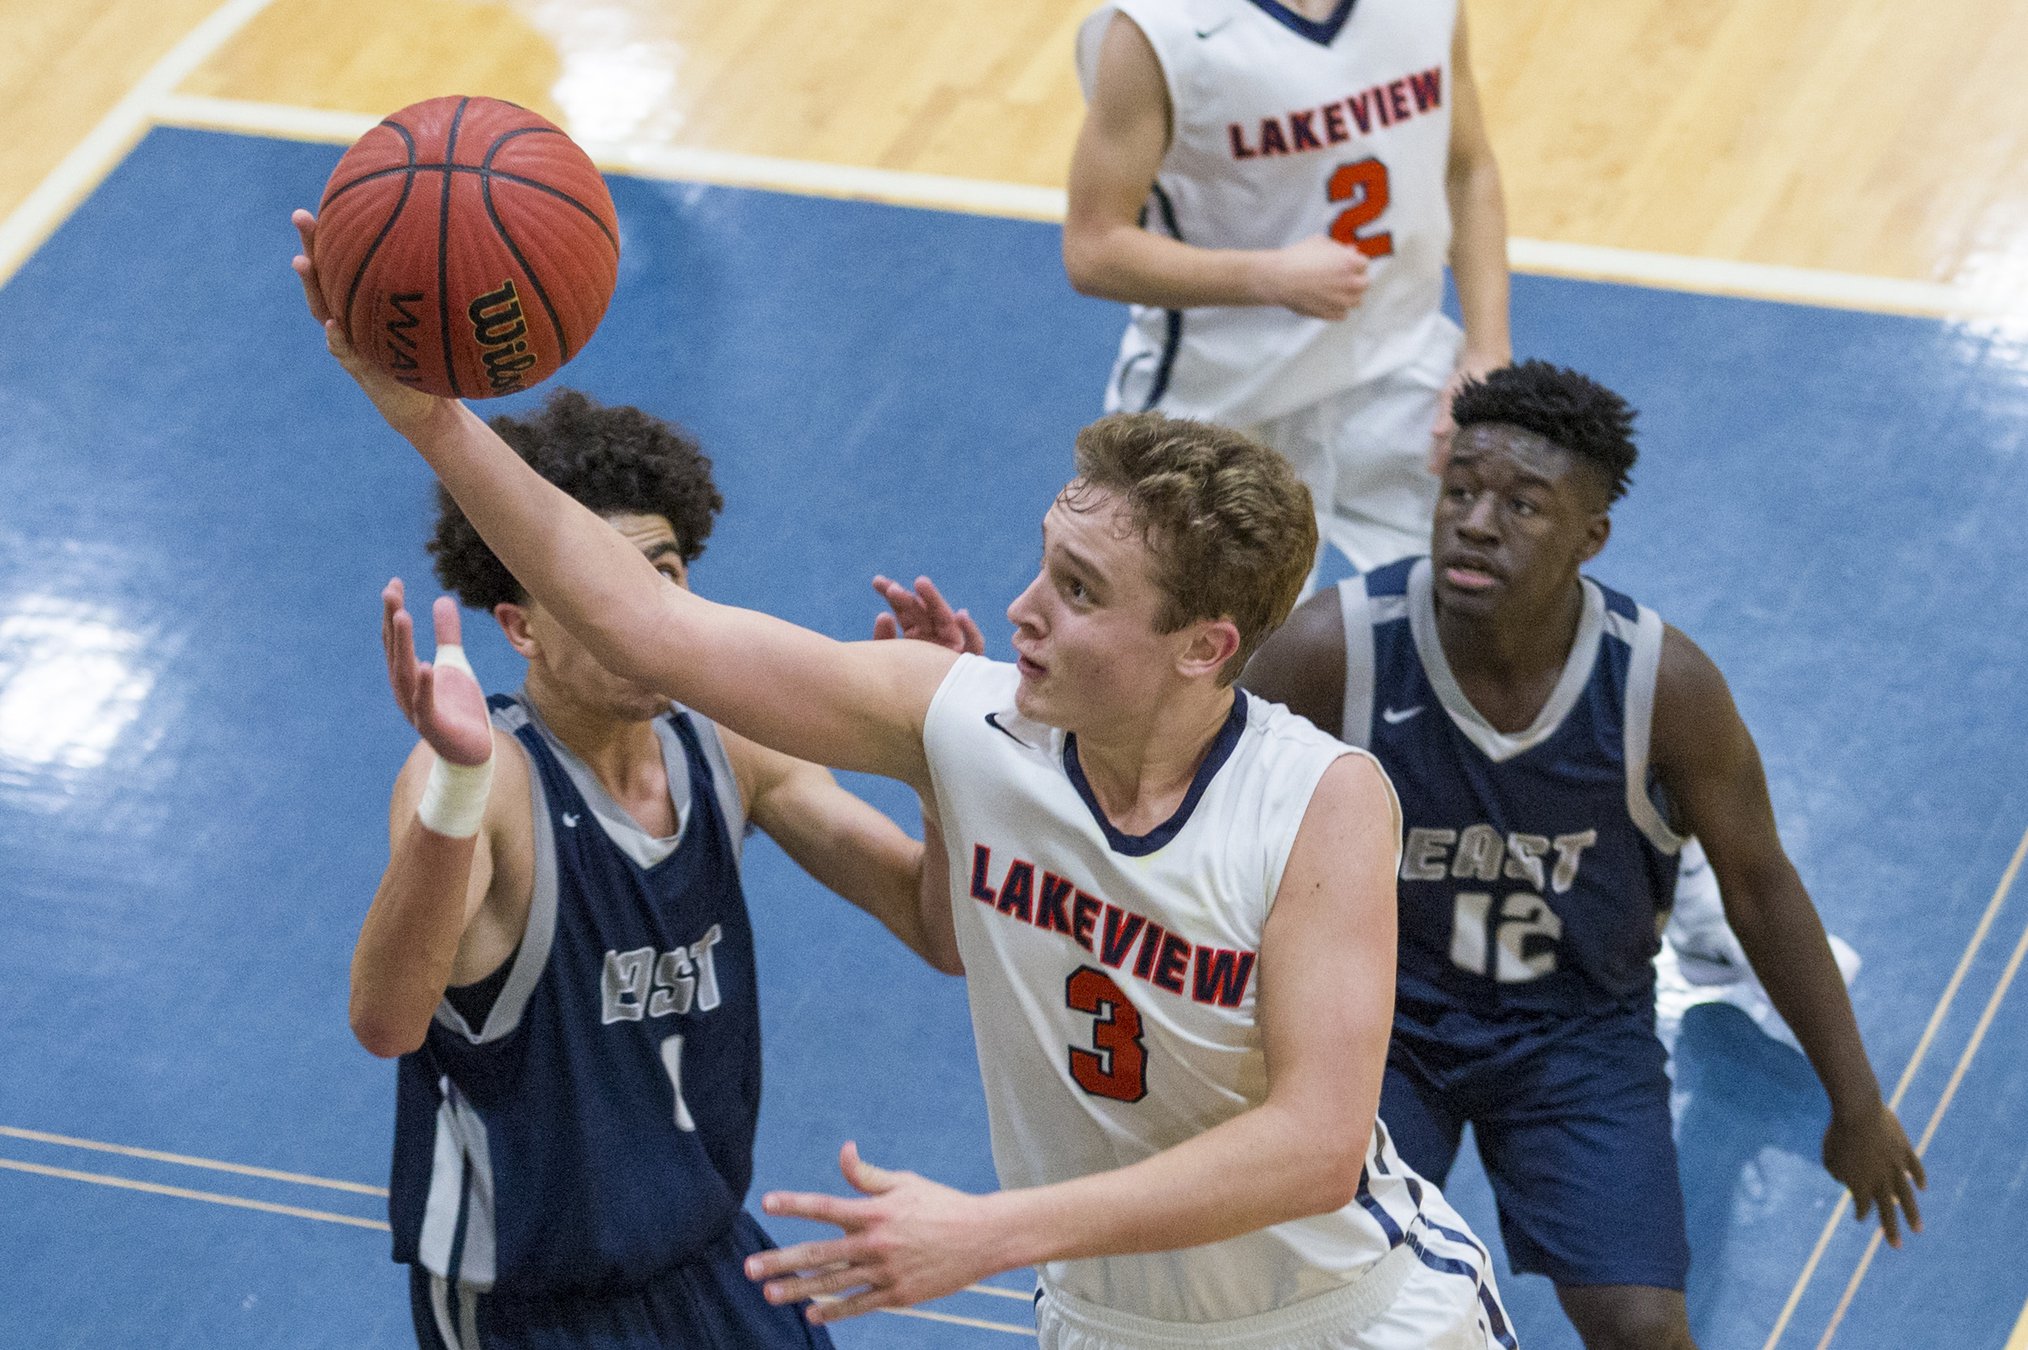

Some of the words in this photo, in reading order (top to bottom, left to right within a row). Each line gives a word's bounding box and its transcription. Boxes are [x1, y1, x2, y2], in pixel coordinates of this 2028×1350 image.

[1227, 66, 1443, 161] LAKEVIEW
[1326, 156, 1393, 259] 2
[1401, 823, 1597, 894] EAST
[970, 843, 1256, 1008] LAKEVIEW
[1450, 892, 1563, 983] 12
[1065, 964, 1149, 1103] 3
[659, 1034, 696, 1132] 1
